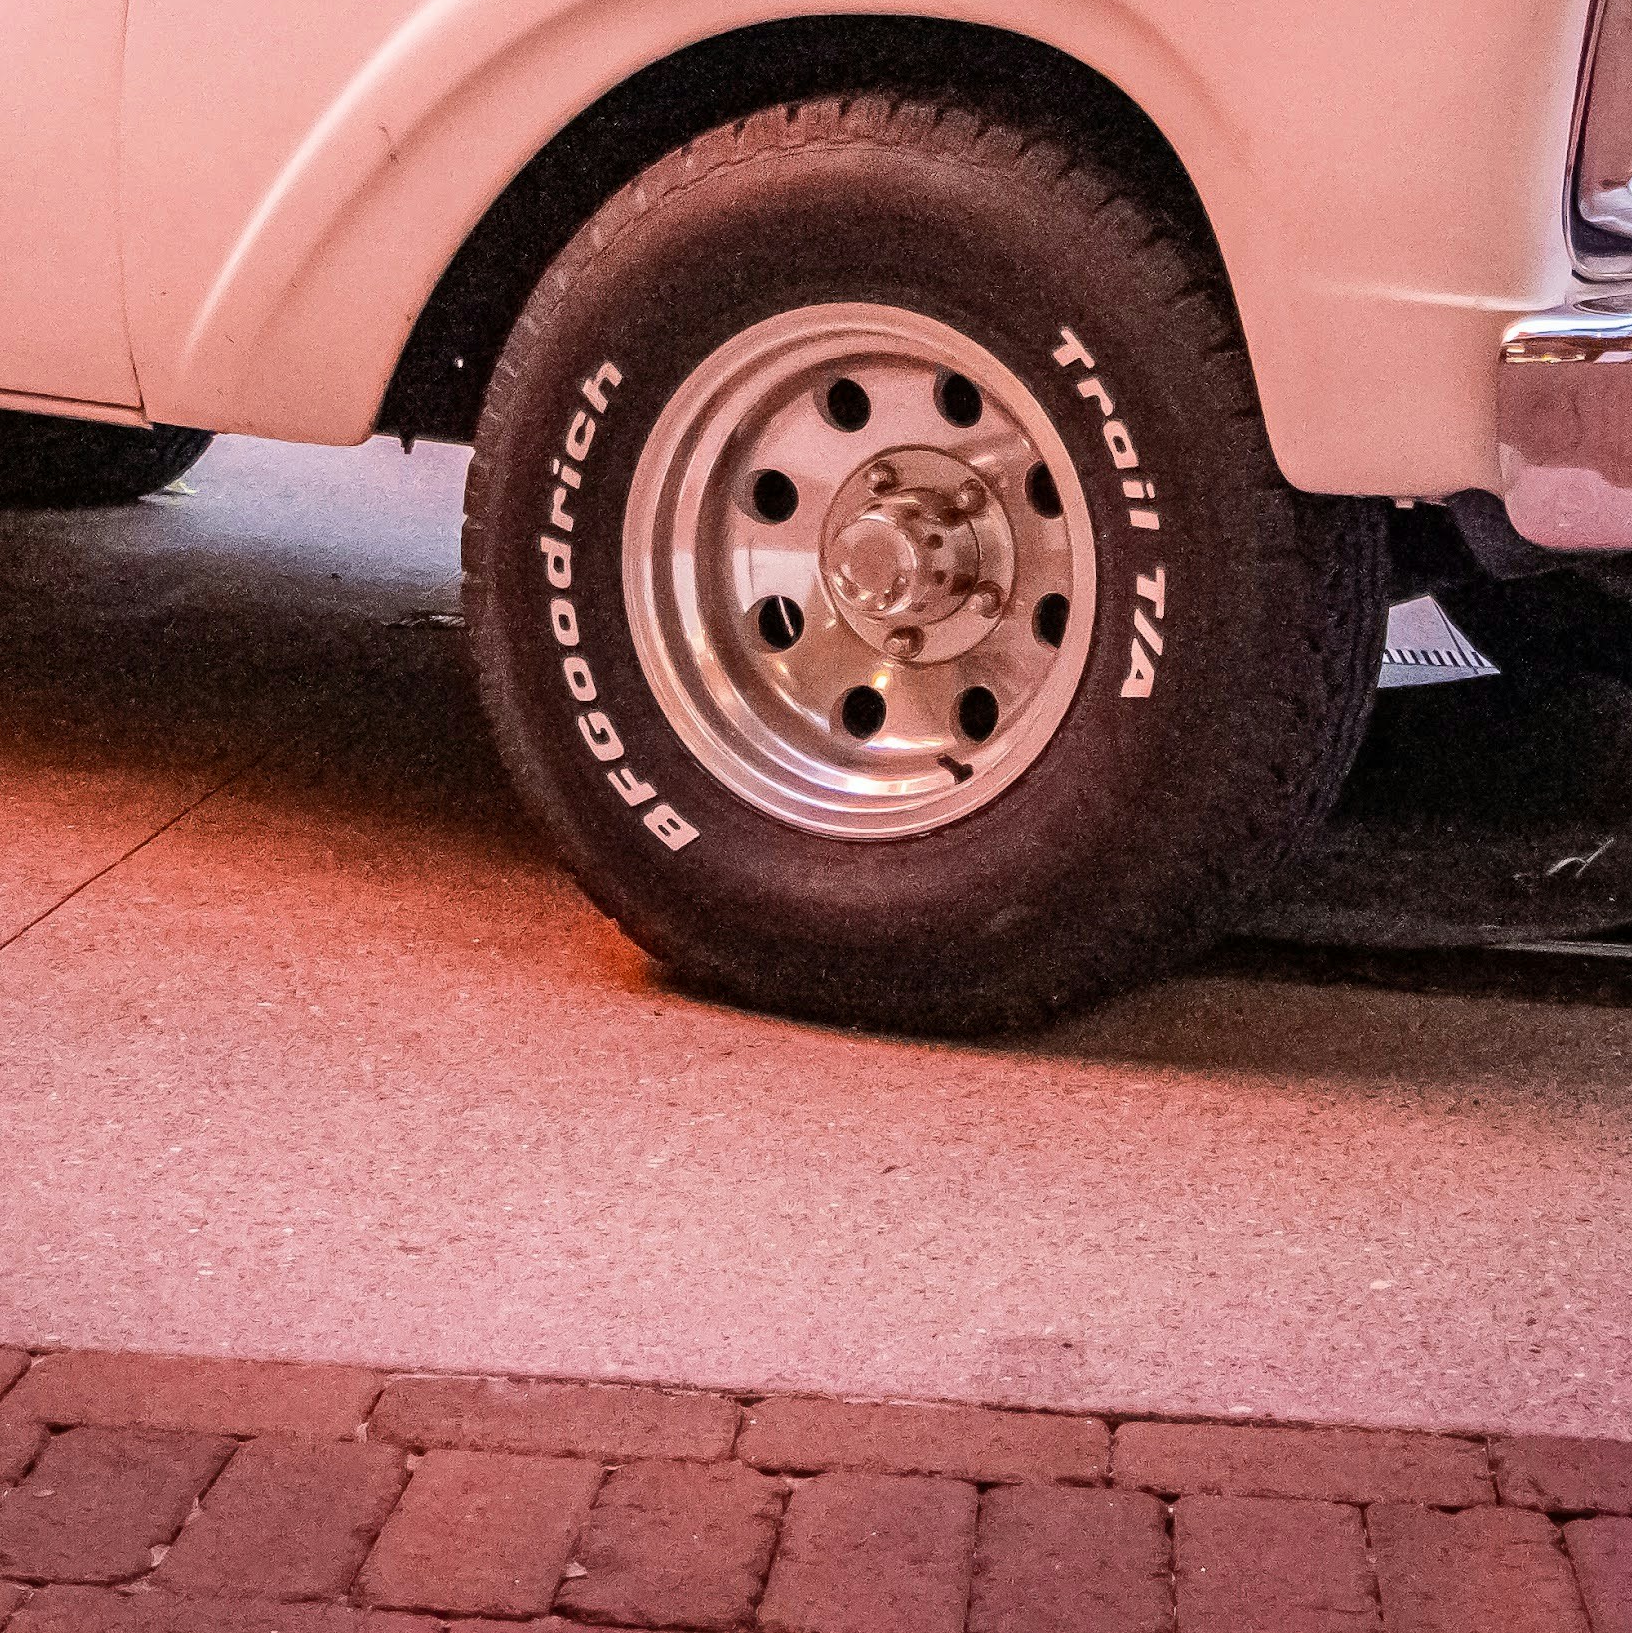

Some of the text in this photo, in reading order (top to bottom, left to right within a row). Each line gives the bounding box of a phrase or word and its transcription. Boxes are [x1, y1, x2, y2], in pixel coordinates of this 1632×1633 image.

[540, 361, 700, 851] BFGoodrich
[1052, 327, 1166, 699] Trail T/A
